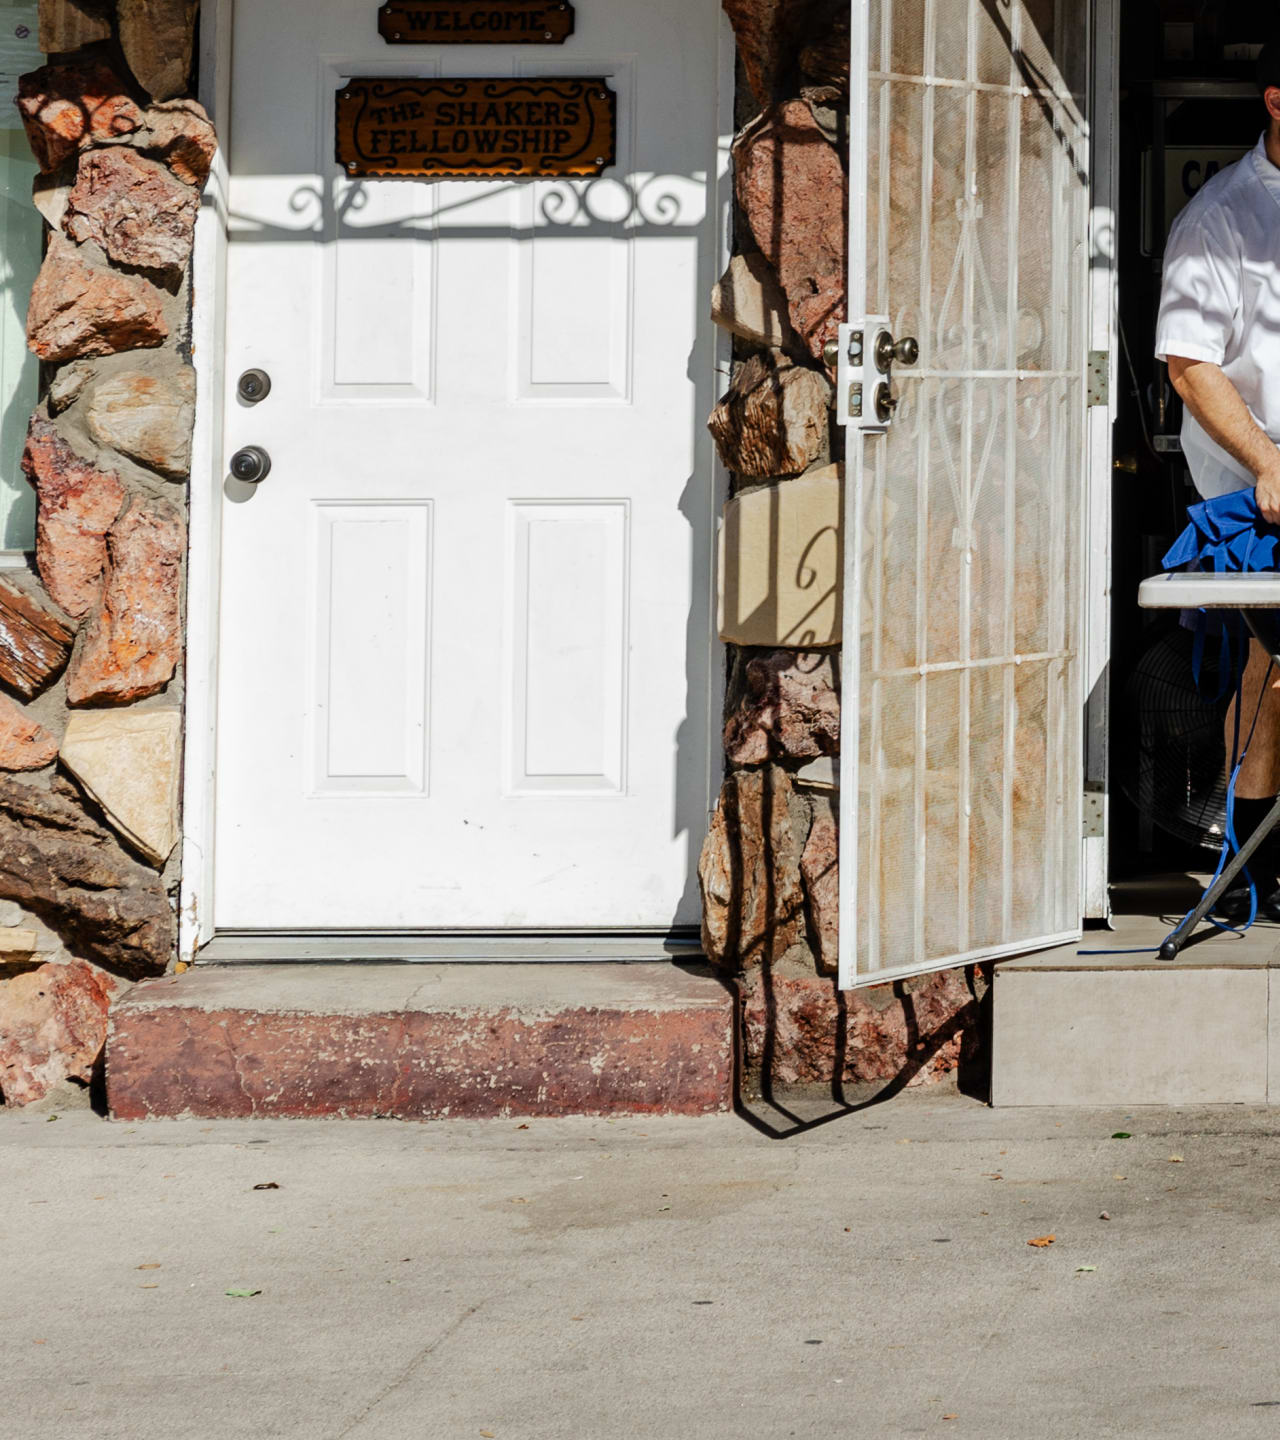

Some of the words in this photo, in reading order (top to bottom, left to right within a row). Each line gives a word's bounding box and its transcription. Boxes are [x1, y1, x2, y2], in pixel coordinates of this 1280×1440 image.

[406, 10, 547, 32] WELCOME
[370, 103, 425, 126] THE
[434, 101, 580, 126] SHAKERS
[370, 129, 572, 154] FELLOWSHIP
